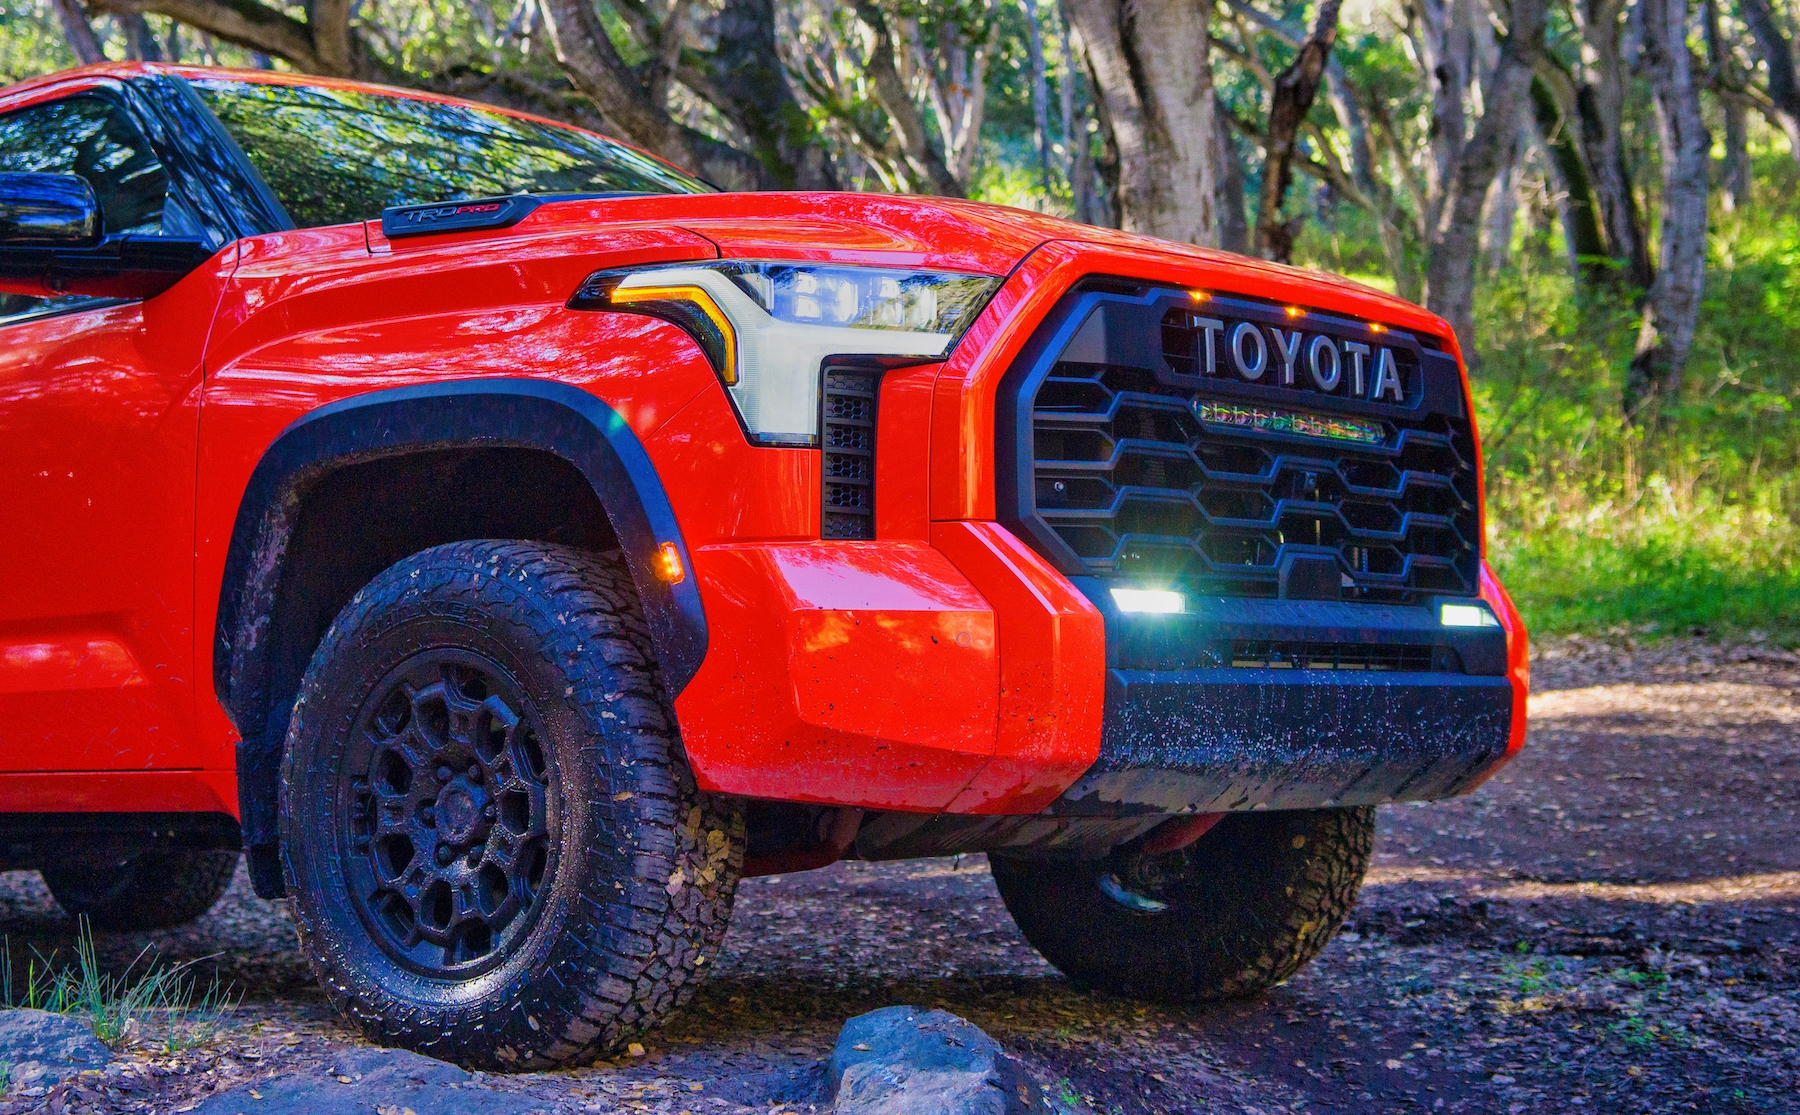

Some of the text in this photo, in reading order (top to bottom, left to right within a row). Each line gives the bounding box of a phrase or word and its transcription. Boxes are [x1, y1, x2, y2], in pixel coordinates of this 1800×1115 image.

[404, 203, 500, 222] TRD PRO
[1193, 315, 1404, 401] TOYOTA
